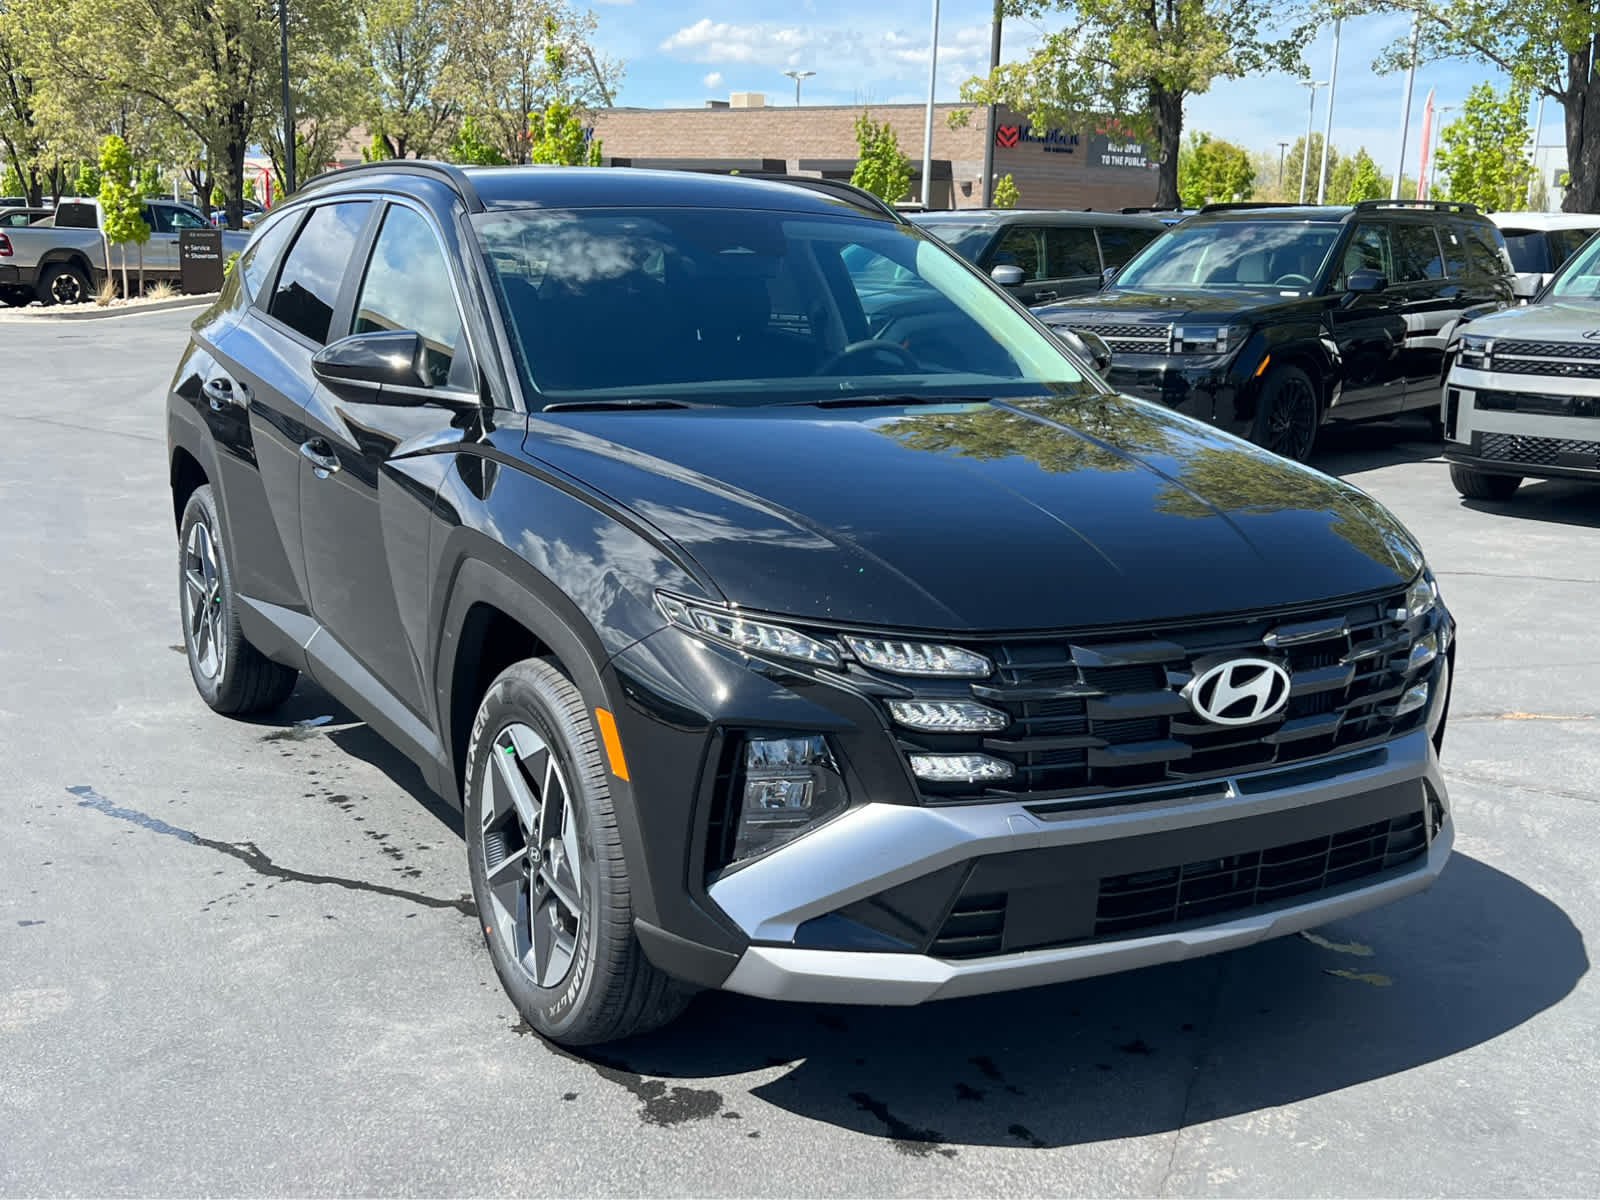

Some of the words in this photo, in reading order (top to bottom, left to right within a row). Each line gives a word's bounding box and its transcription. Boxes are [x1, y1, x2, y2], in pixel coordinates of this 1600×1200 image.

[1124, 143, 1142, 154] OPEN
[1101, 155, 1111, 166] TO
[1111, 155, 1124, 166] THE
[1124, 156, 1147, 168] PUBLIC
[464, 704, 490, 808] NEXEN
